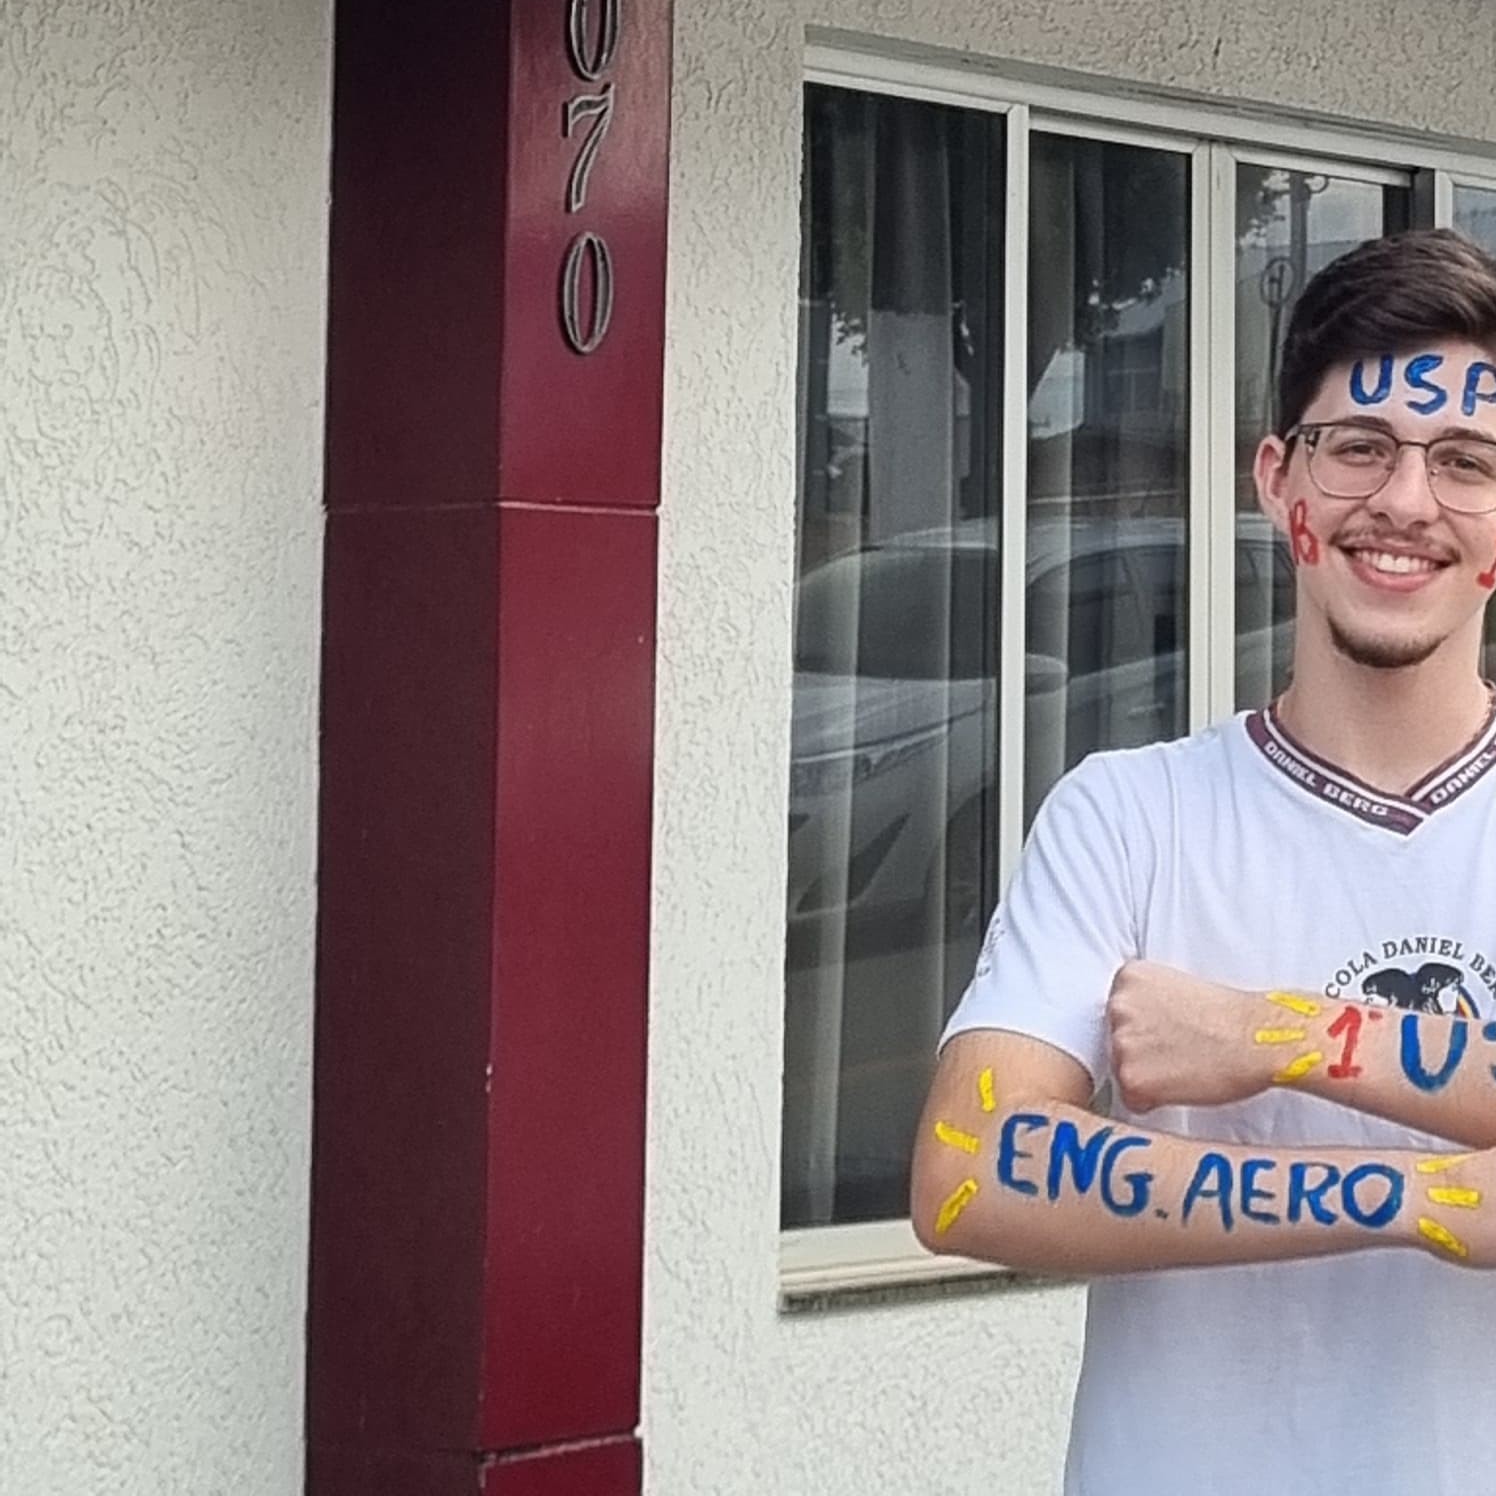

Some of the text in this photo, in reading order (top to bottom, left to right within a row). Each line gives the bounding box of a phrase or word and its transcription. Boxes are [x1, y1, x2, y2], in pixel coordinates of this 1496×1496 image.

[1263, 740, 1389, 817] DANIEL BERG
[1325, 951, 1378, 999] COLA
[1382, 936, 1465, 961] DANIEL
